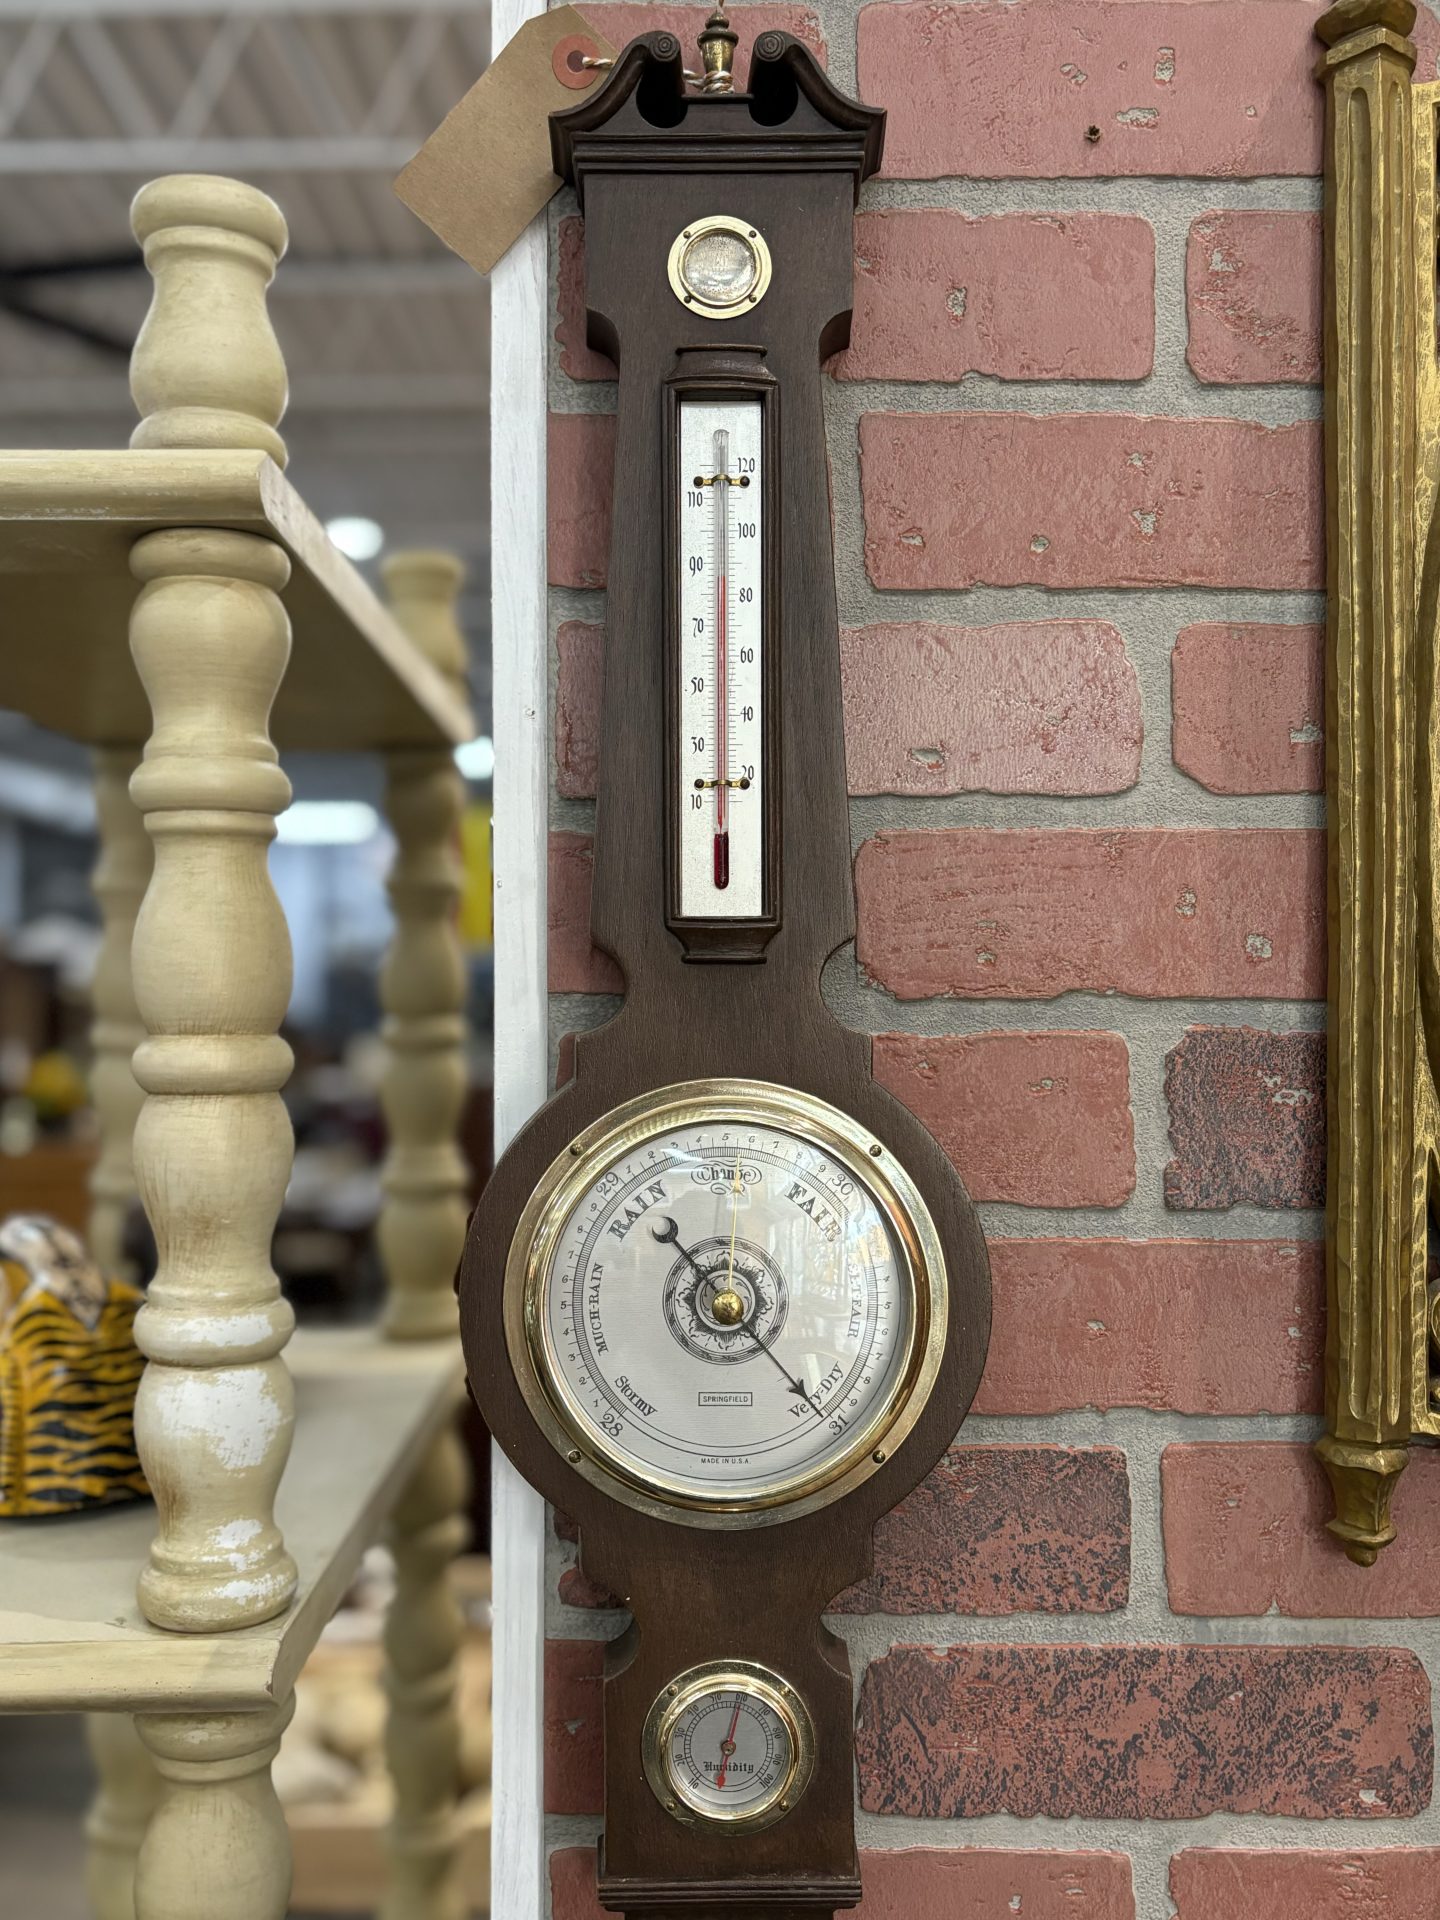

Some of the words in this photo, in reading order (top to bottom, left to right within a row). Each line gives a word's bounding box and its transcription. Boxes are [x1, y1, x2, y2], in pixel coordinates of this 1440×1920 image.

[738, 457, 755, 473] 120
[688, 492, 703, 508] 110
[738, 523, 756, 539] 100
[689, 556, 703, 577] 90
[739, 587, 753, 602] 80
[692, 617, 704, 638] 70
[740, 646, 754, 663] 60
[691, 677, 704, 696] 50
[740, 706, 754, 723] 40
[691, 736, 704, 754] 30
[741, 765, 754, 780] 20
[691, 794, 702, 810] 10
[696, 1135, 702, 1143] 4
[722, 1133, 730, 1141] 5
[748, 1135, 756, 1143] 6
[773, 1141, 780, 1149] 7
[648, 1150, 656, 1159] 2
[626, 1165, 632, 1174] 1
[818, 1164, 826, 1173] 9
[596, 1171, 619, 1196] 29
[832, 1174, 854, 1196] 30
[590, 1203, 598, 1212] 9
[606, 1178, 667, 1242] RAIN
[784, 1181, 842, 1242] FAIR
[577, 1225, 584, 1234] 8
[568, 1250, 574, 1259] 7
[562, 1274, 569, 1283] 6
[560, 1300, 568, 1310] 5
[588, 1262, 610, 1356] MUCH-RAIN
[884, 1301, 892, 1310] 5
[562, 1328, 570, 1336] 4
[882, 1328, 889, 1336] 6
[568, 1353, 576, 1362] 3
[875, 1352, 883, 1360] 7
[578, 1376, 587, 1385] 2
[863, 1376, 872, 1384] 8
[614, 1375, 658, 1416] Stormy
[592, 1399, 598, 1408] 1
[848, 1398, 858, 1406] 9
[600, 1414, 624, 1437] 28
[828, 1414, 850, 1436] 31
[703, 1762, 754, 1774] Humidity
